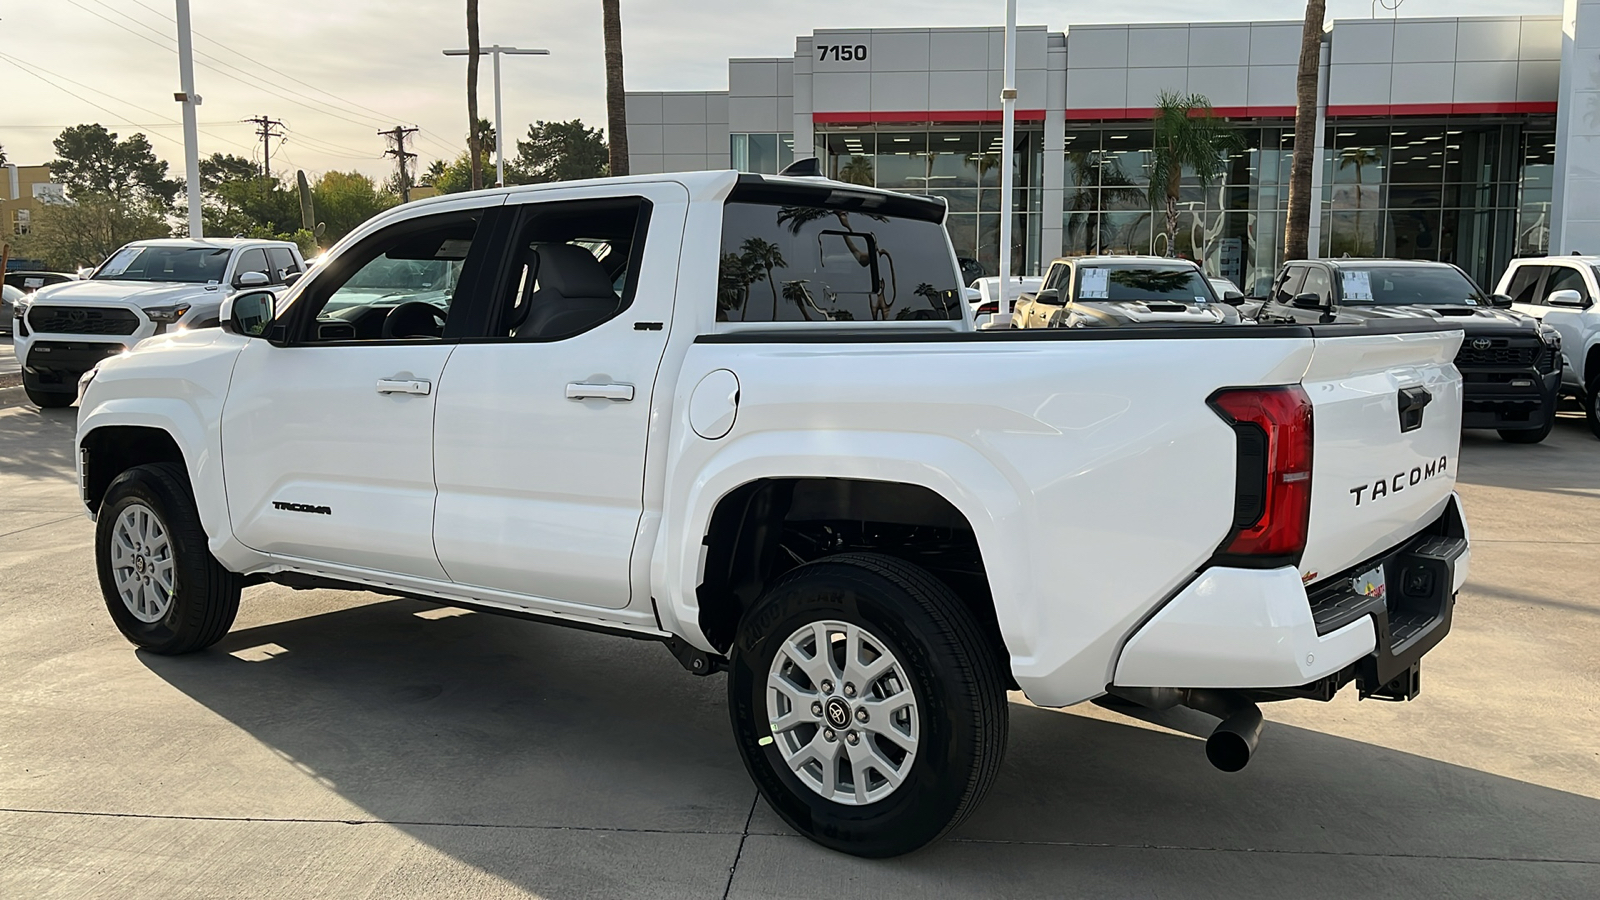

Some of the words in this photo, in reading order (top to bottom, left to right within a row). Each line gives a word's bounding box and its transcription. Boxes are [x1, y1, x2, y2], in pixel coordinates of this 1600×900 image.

[817, 45, 867, 61] 7150
[1350, 456, 1447, 506] TACOMA
[272, 501, 332, 515] TACOMA
